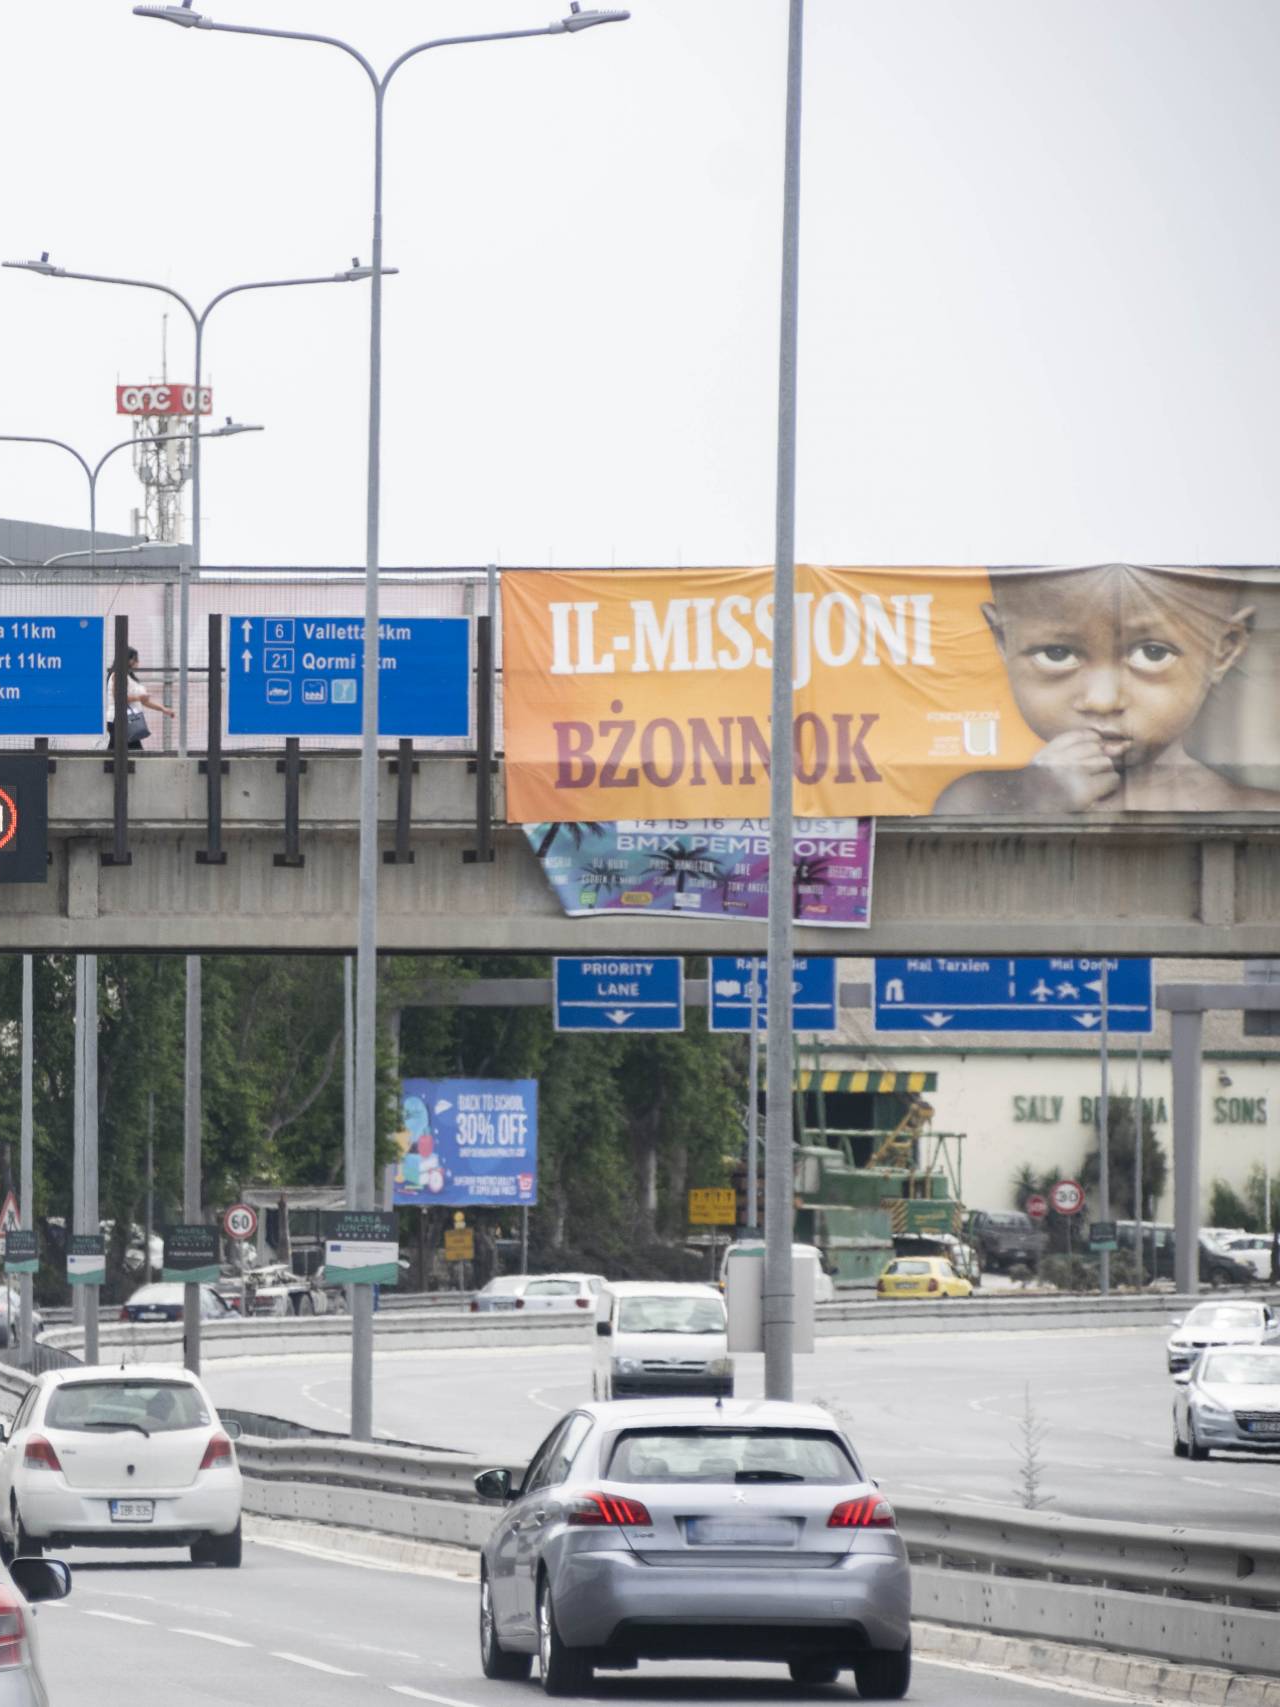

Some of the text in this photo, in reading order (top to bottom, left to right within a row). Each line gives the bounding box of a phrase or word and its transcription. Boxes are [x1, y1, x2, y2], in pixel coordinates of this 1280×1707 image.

[11, 623, 56, 639] 11km
[275, 623, 284, 638] 6
[549, 591, 936, 690] IL-MISSJONI
[17, 653, 62, 669] 11km
[272, 654, 288, 669] 21
[302, 652, 356, 670] Qormi
[553, 700, 882, 789] BŻONNOK
[740, 818, 845, 833] AUUST
[616, 835, 857, 858] BMX PEMBOKE
[582, 962, 654, 976] PRIORITY
[937, 958, 990, 972] Tarxien
[597, 982, 640, 997] LANE
[1213, 1097, 1268, 1124] SONS
[456, 1112, 528, 1145] 30% OFF
[231, 1214, 250, 1230] 60
[344, 1215, 381, 1223] MARSA
[336, 1224, 391, 1232] JUNCTION
